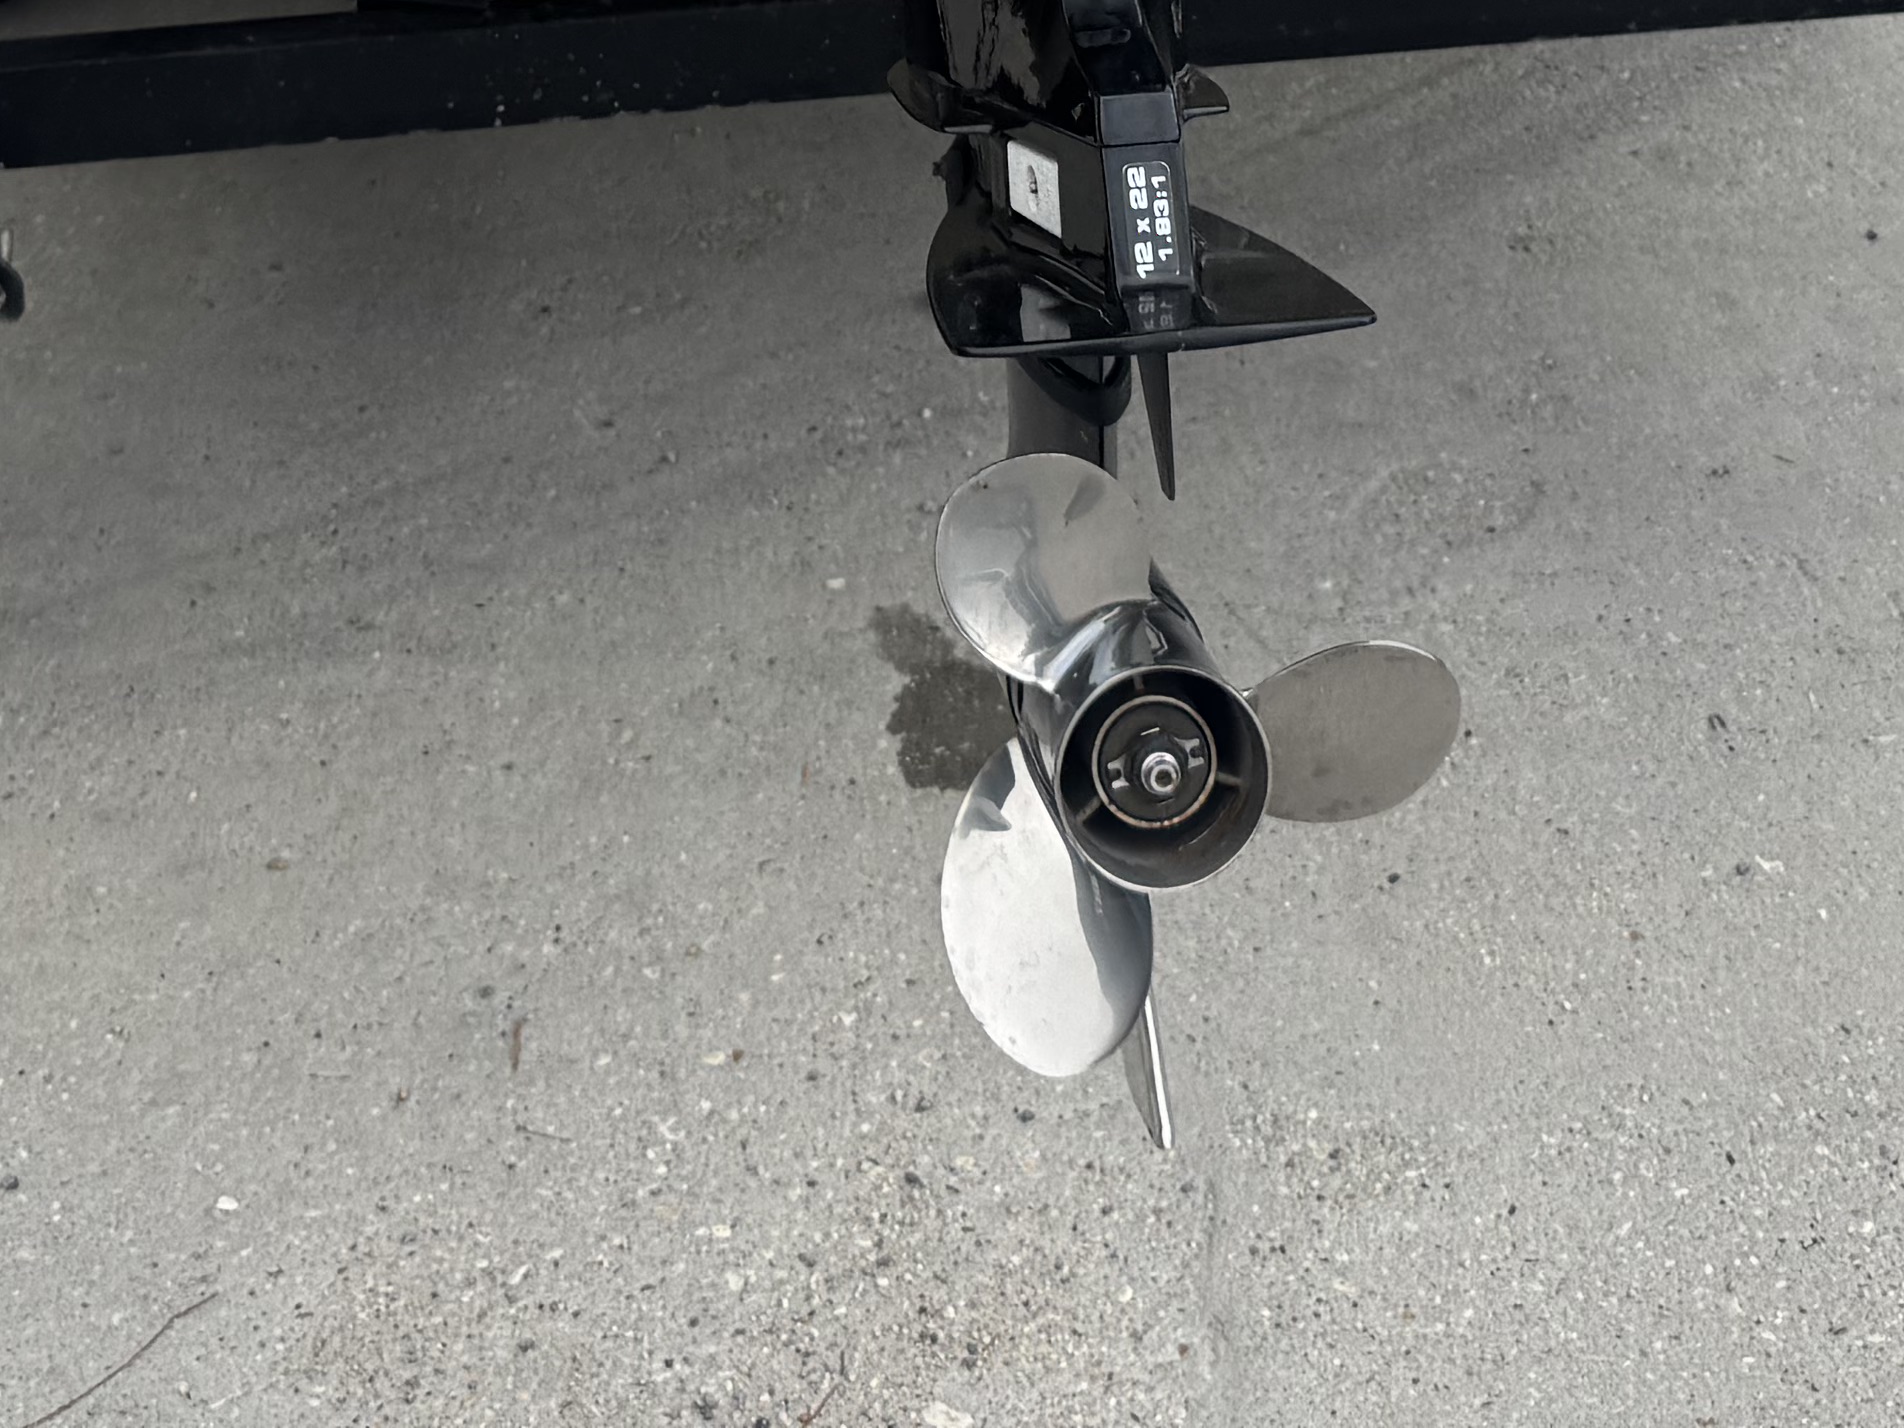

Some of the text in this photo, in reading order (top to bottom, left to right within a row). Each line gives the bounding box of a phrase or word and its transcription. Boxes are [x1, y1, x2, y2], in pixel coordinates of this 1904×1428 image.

[1126, 166, 1149, 210] 22
[1150, 175, 1174, 262] 1.83:1
[1134, 241, 1155, 280] 12
